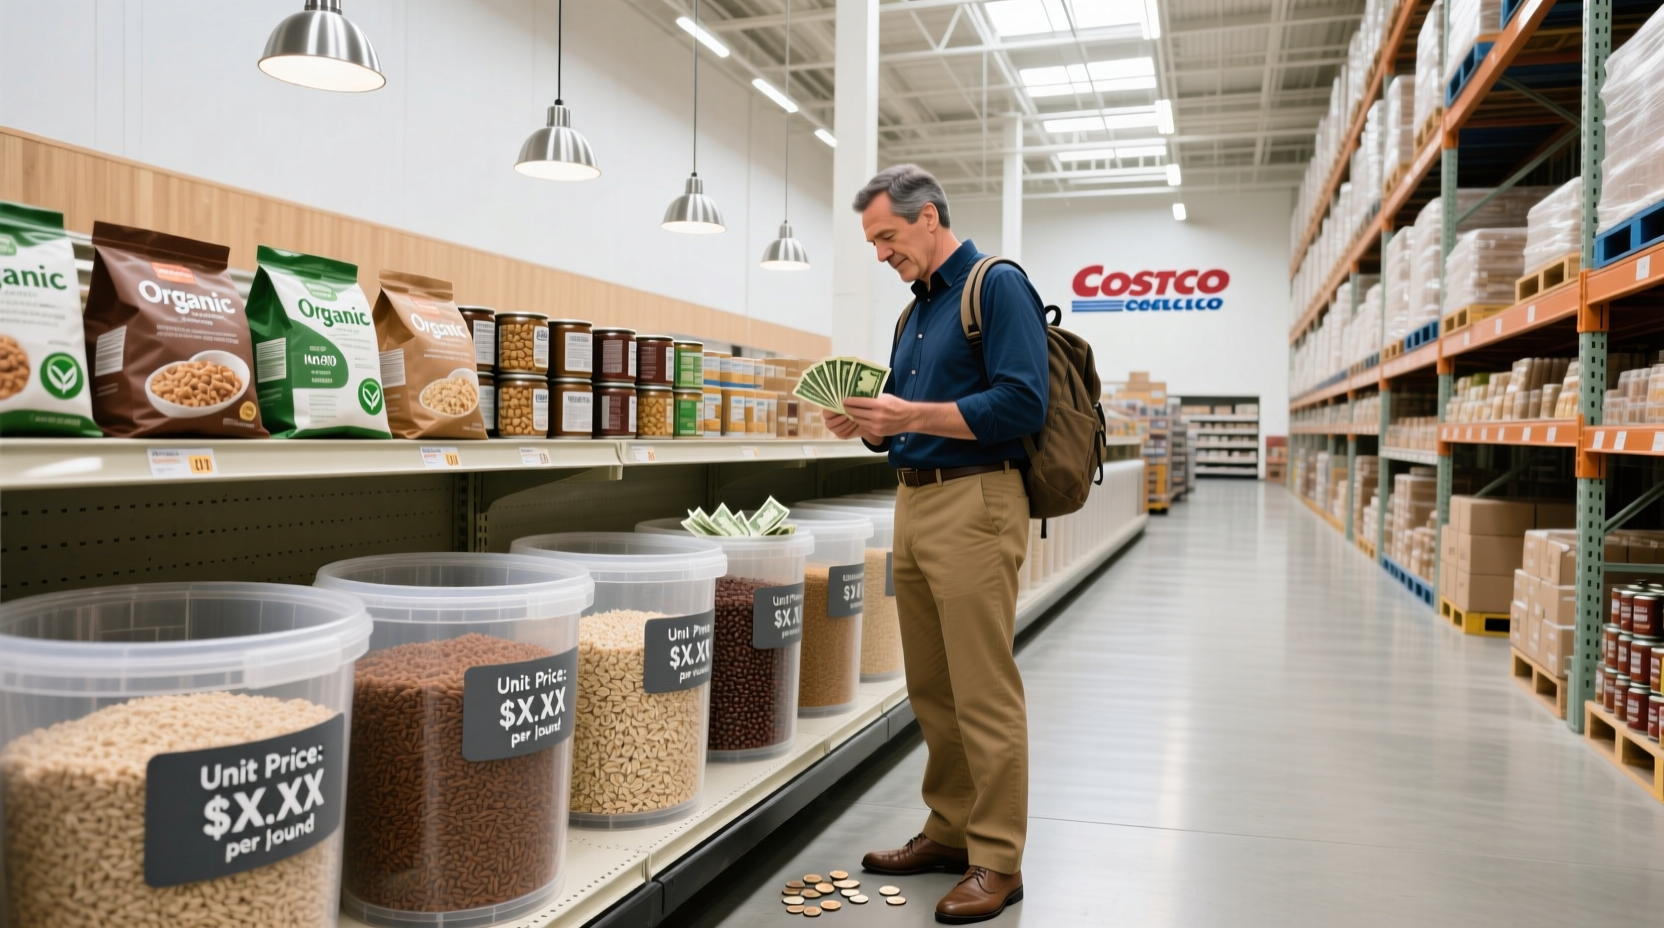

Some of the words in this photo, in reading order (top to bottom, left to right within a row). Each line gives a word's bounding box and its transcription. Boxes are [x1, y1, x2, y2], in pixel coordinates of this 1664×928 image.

[0, 265, 67, 290] anic
[139, 280, 236, 314] Organic
[298, 298, 371, 328] Organic
[497, 674, 531, 695] Unit
[535, 668, 567, 689] Price:
[499, 686, 566, 732] $X.XX
[511, 730, 532, 749] per
[200, 758, 259, 790] Unit
[265, 744, 324, 779] Price:
[203, 768, 325, 842] $X.XX
[225, 838, 261, 864] per
